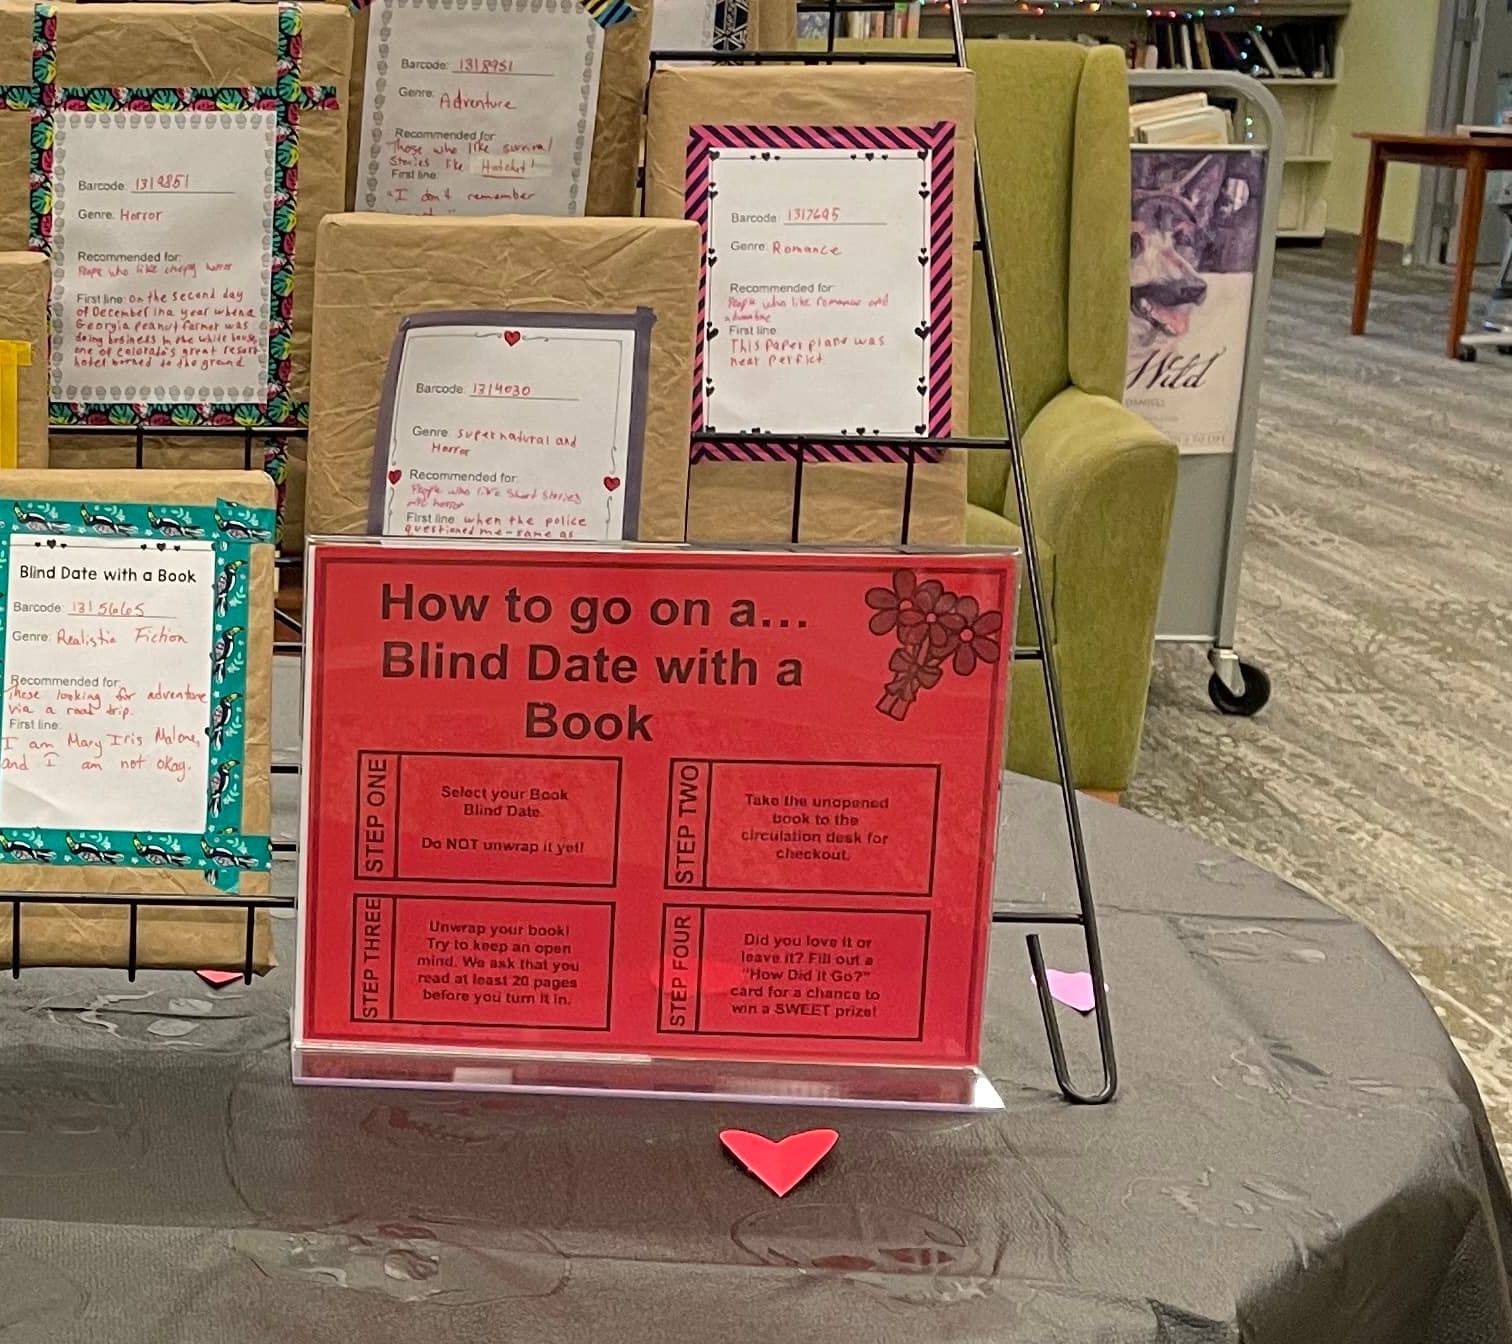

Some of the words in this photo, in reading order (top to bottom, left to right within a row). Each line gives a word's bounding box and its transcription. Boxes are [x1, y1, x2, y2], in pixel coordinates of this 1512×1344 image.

[440, 87, 517, 110] Adventure
[1126, 346, 1227, 389] Wild
[20, 566, 55, 579] Blind
[61, 566, 97, 580] Date
[103, 568, 137, 582] with
[143, 571, 152, 582] a
[158, 569, 196, 583] Book
[381, 584, 489, 624] How
[506, 587, 552, 624] to
[570, 597, 631, 634] go
[650, 595, 711, 628] on
[729, 595, 808, 630] a...
[381, 640, 508, 680] Blind
[528, 646, 639, 684] Date
[656, 648, 757, 687] with
[776, 657, 802, 687] a
[525, 702, 653, 742] Book
[367, 759, 387, 807] ONE
[678, 765, 699, 814] TWO
[441, 786, 487, 799] Select
[491, 788, 524, 801] your
[530, 789, 568, 801] Book
[745, 794, 779, 805] Take
[784, 794, 807, 806] the
[812, 797, 889, 811] unopened
[464, 804, 502, 816] Blind
[773, 813, 809, 824] book
[815, 815, 829, 826] to
[836, 814, 859, 826] the
[365, 815, 384, 873] STEP
[741, 828, 821, 842] circulation
[826, 831, 861, 844] desk
[867, 832, 888, 845] for
[422, 837, 441, 849] Do
[446, 839, 479, 850] NOT
[484, 840, 538, 853] unwrap
[543, 842, 553, 853] it
[556, 842, 584, 856] yet!
[675, 825, 695, 883] STEP
[364, 898, 381, 962] THREE
[429, 920, 486, 936] Unwrap
[490, 925, 523, 937] your
[427, 938, 450, 952] Try
[454, 939, 469, 950] to
[473, 940, 508, 954] keep
[512, 943, 530, 953] an
[534, 944, 571, 955] open
[673, 916, 691, 971] FOUR
[744, 934, 769, 946] Did
[774, 936, 801, 948] you
[806, 936, 837, 947] love
[843, 936, 852, 948] it
[856, 939, 873, 949] or
[417, 955, 457, 967] mind.
[463, 958, 485, 968] We
[490, 958, 515, 969] ask
[520, 958, 548, 971] that
[552, 962, 579, 974] you
[741, 951, 780, 963] leave
[784, 952, 804, 964] it?
[808, 953, 831, 964] Fill
[836, 954, 860, 965] out
[865, 957, 873, 965] a
[418, 973, 450, 984] read
[454, 974, 468, 984] at
[473, 974, 508, 986] least
[513, 975, 529, 986] 20
[534, 978, 577, 990] pages
[788, 969, 812, 981] Did
[363, 969, 379, 1018] STEP
[423, 989, 470, 1002] before
[474, 992, 501, 1004] you
[506, 993, 535, 1003] turn
[540, 994, 549, 1004] it
[554, 994, 571, 1005] in.
[730, 985, 763, 998] card
[768, 986, 788, 998] for
[793, 989, 802, 998] a
[806, 988, 855, 1000] chance
[865, 989, 880, 1000] to
[670, 977, 687, 1027] STEP
[732, 1003, 757, 1014] win
[762, 1005, 770, 1014] a
[774, 1003, 830, 1016] SWEET
[835, 1005, 877, 1018] prize!
